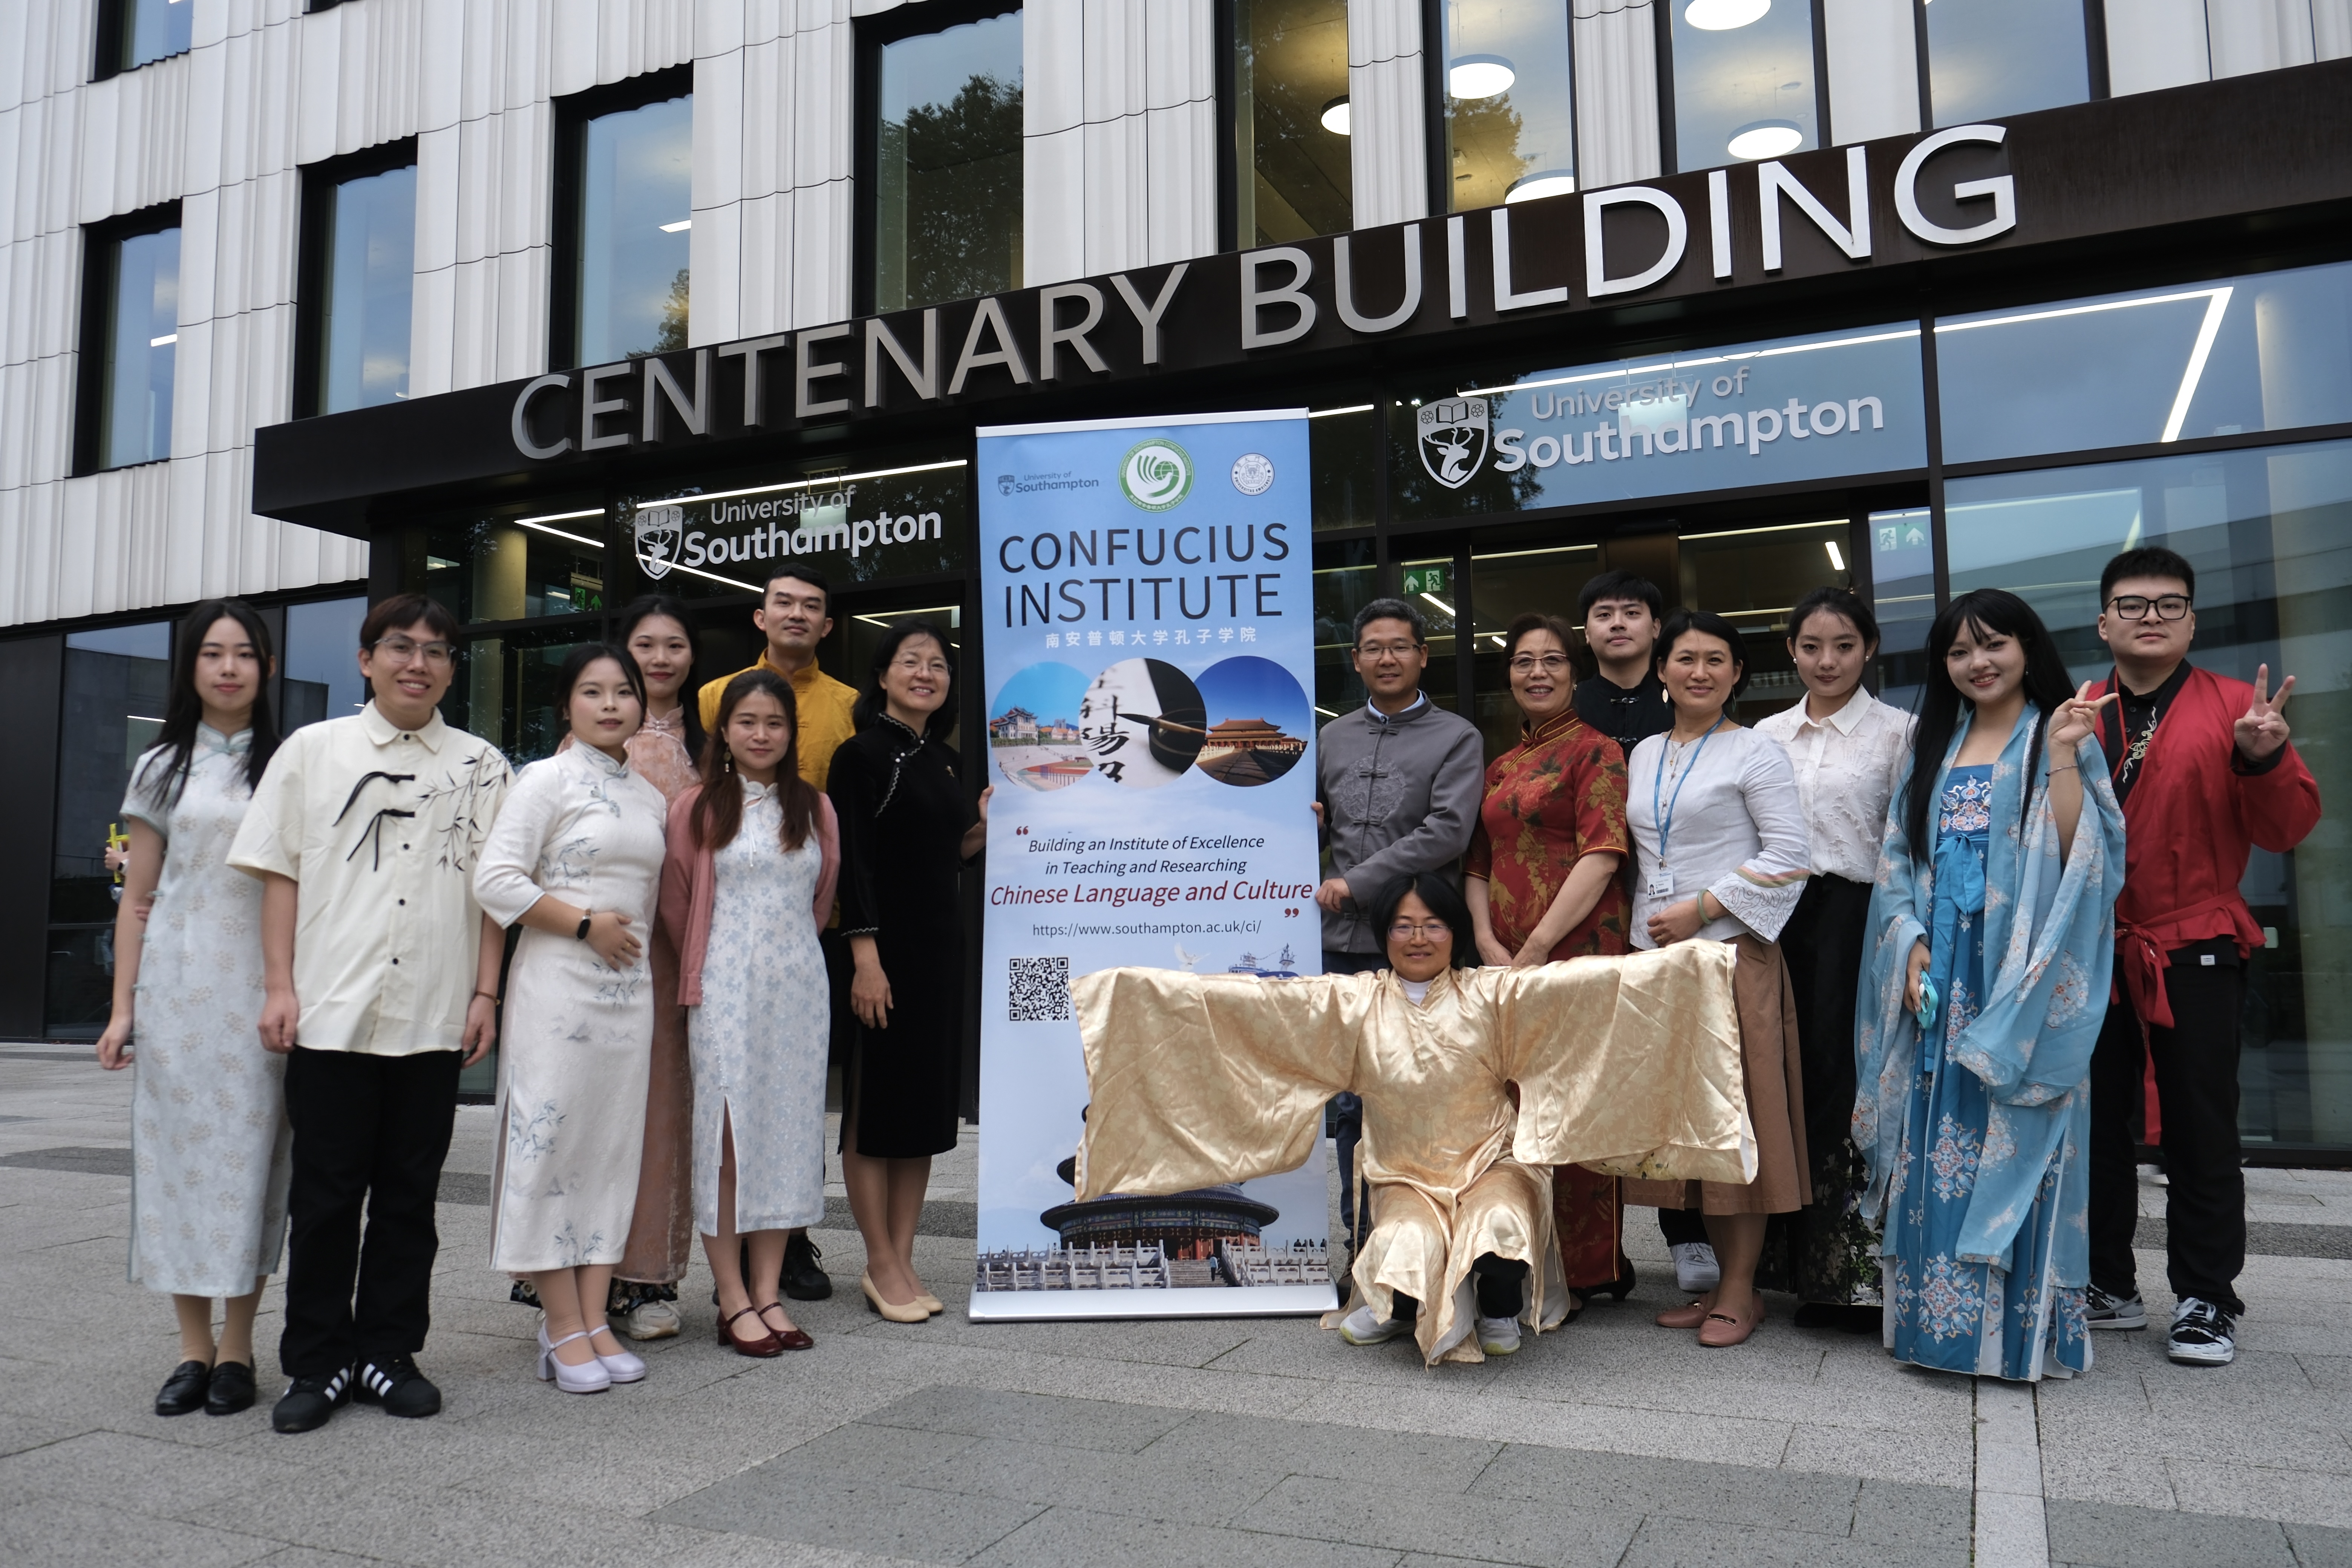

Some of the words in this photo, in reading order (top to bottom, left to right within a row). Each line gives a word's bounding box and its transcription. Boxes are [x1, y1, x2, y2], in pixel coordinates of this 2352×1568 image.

[511, 263, 1190, 460] CENTENARY
[1240, 124, 2017, 350] BUILDING
[1531, 377, 1701, 420] University
[1712, 367, 1750, 397] of
[1493, 396, 1883, 472] Southampton
[1015, 478, 1099, 493] Southampton
[1024, 472, 1061, 481] University
[711, 492, 823, 524] University
[830, 485, 857, 508] of
[684, 511, 942, 567] Southampton
[999, 523, 1289, 573] CONFUCIUS
[1006, 574, 1282, 628] INSTITUTE
[1046, 626, 1256, 648] 南安普顿大学孔子学院
[1029, 838, 1085, 854] Building
[1088, 841, 1105, 850] an
[1110, 838, 1168, 850] Institute
[1172, 836, 1189, 849] of
[1190, 835, 1264, 849] Excellence
[1046, 862, 1057, 874] in
[1063, 861, 1126, 876] Teaching
[1129, 860, 1157, 873] and
[1160, 859, 1247, 874] Researching
[991, 886, 1068, 905] Chinese
[1074, 884, 1179, 907] Language
[1185, 880, 1228, 900] and
[1233, 879, 1312, 900] Culture
[1033, 920, 1261, 938] https://www.southampton.ac.uk/ci/
